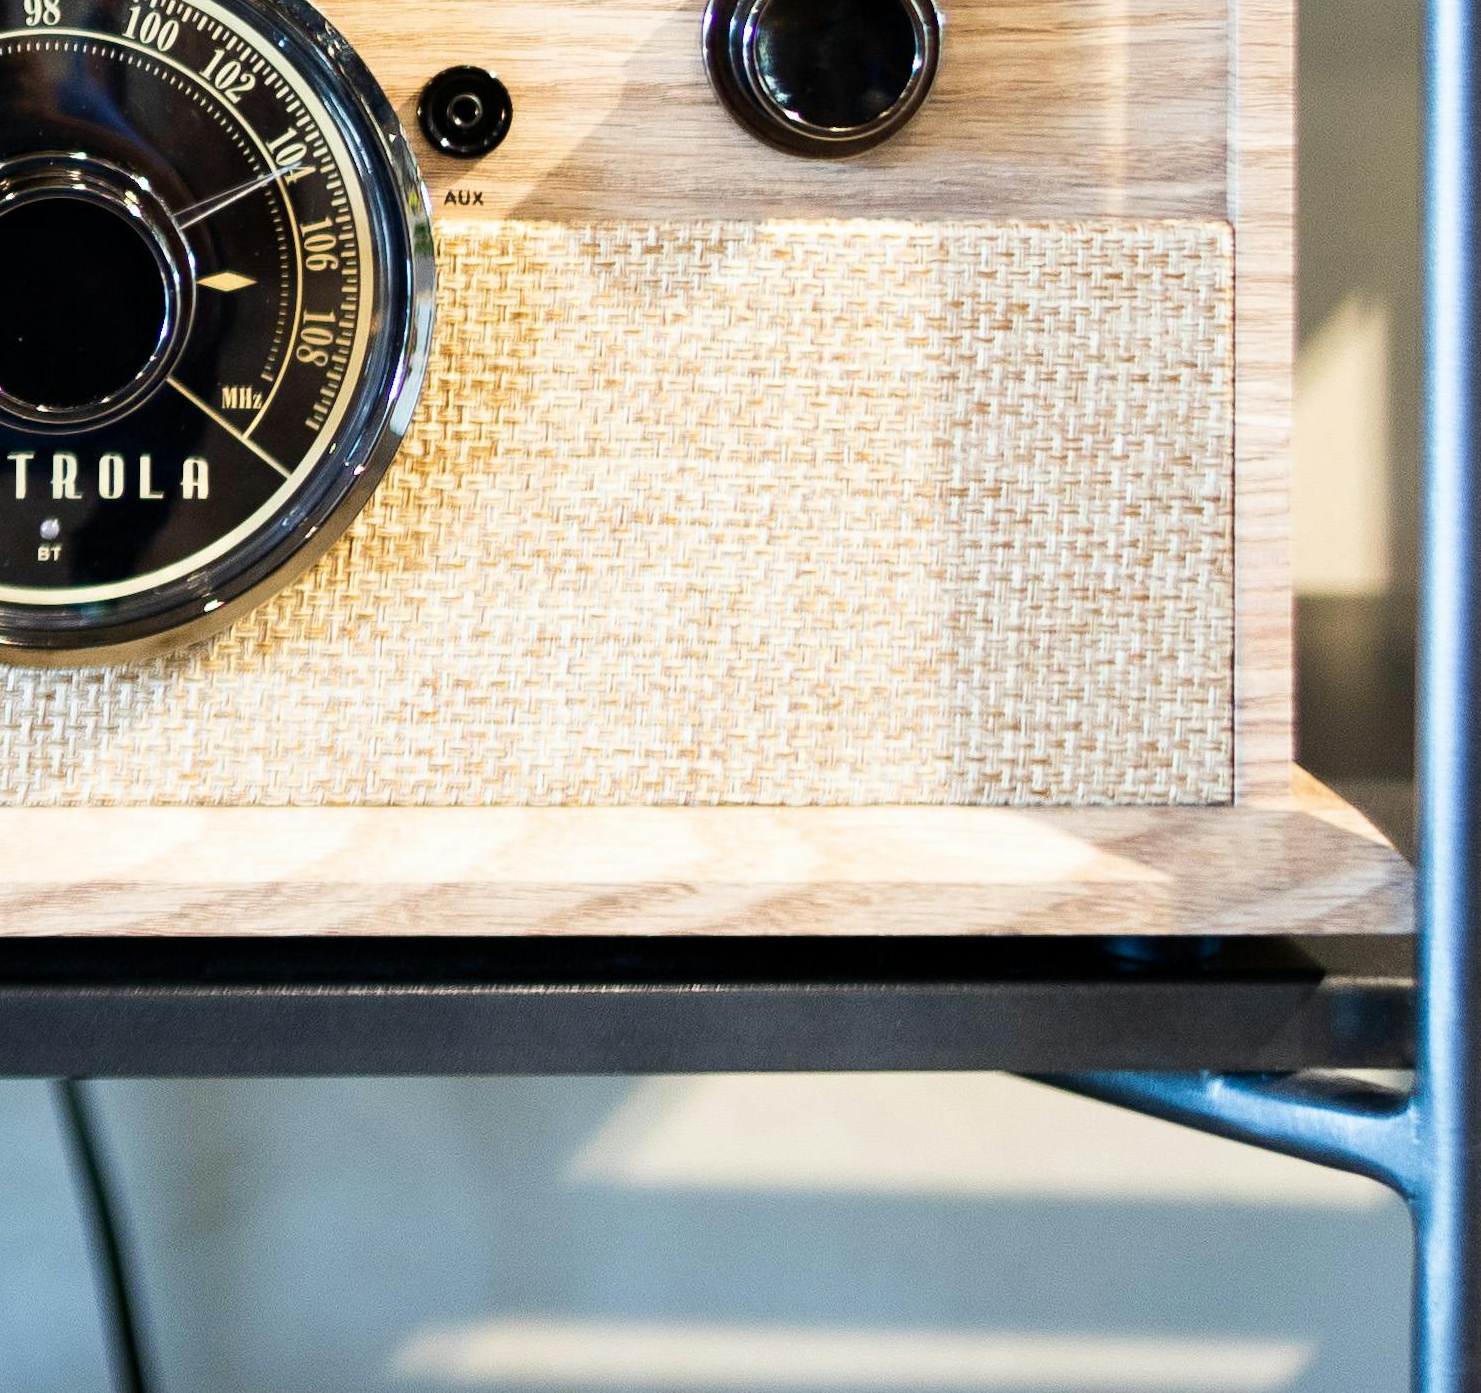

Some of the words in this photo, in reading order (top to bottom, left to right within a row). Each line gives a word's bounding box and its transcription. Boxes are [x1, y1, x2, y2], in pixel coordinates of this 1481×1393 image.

[122, 6, 179, 52] 100
[198, 49, 256, 104] 102
[266, 127, 317, 185] 104
[443, 189, 484, 206] AUX
[300, 216, 338, 271] 106
[296, 309, 336, 367] 108
[221, 386, 263, 409] MHz
[37, 545, 63, 562] BT
